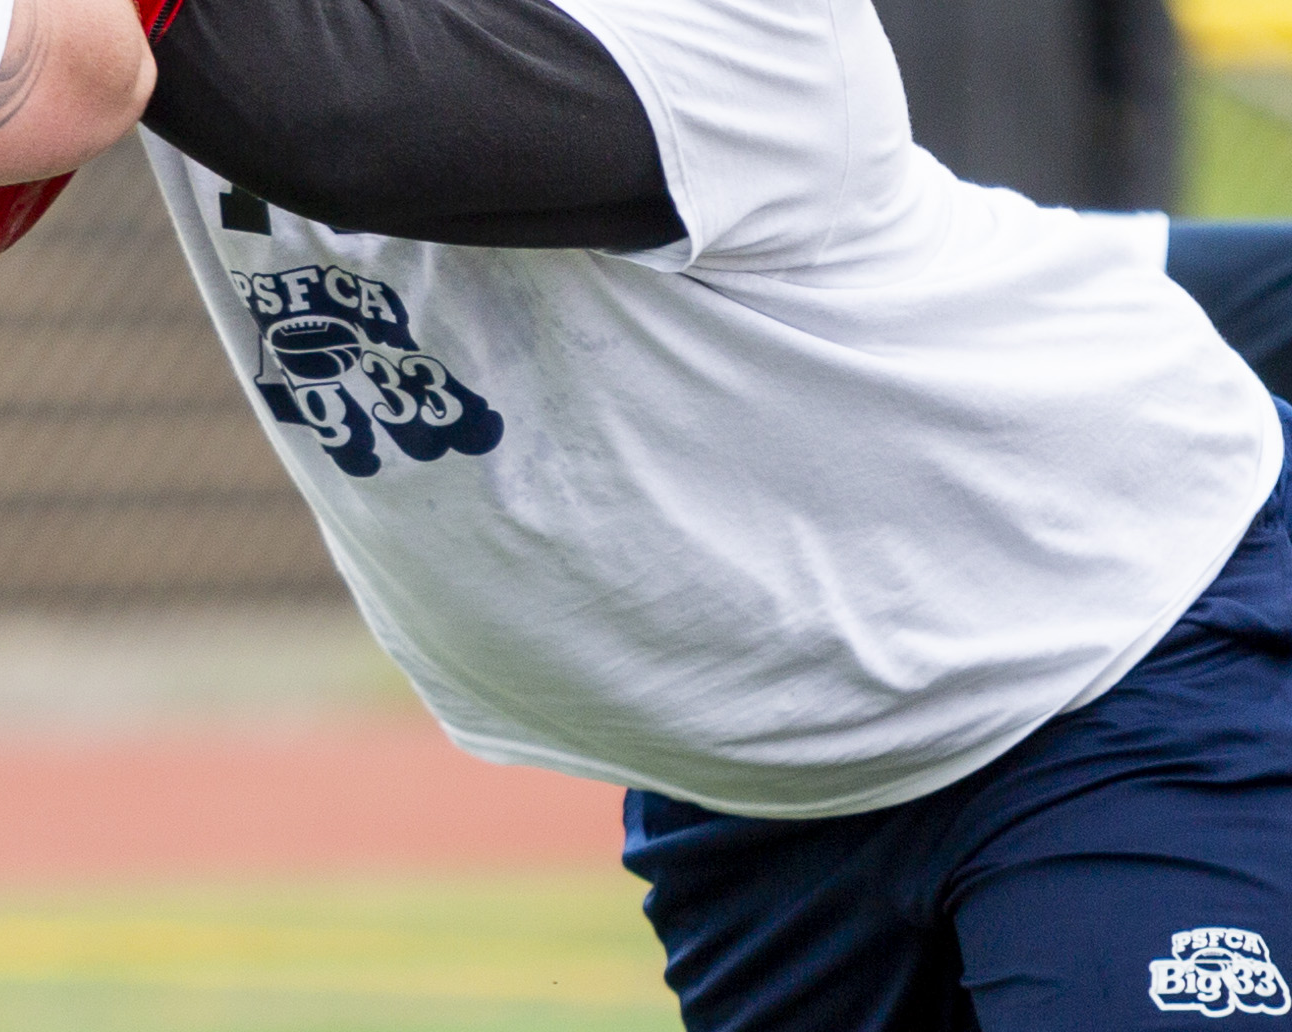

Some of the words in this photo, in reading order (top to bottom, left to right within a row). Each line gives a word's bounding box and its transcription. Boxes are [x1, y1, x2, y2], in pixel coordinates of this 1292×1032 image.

[231, 267, 400, 325] PSFCA
[360, 350, 464, 427] 33
[1175, 930, 1262, 956] PSFCA
[1155, 965, 1223, 1002] Big
[1232, 965, 1278, 998] 33
